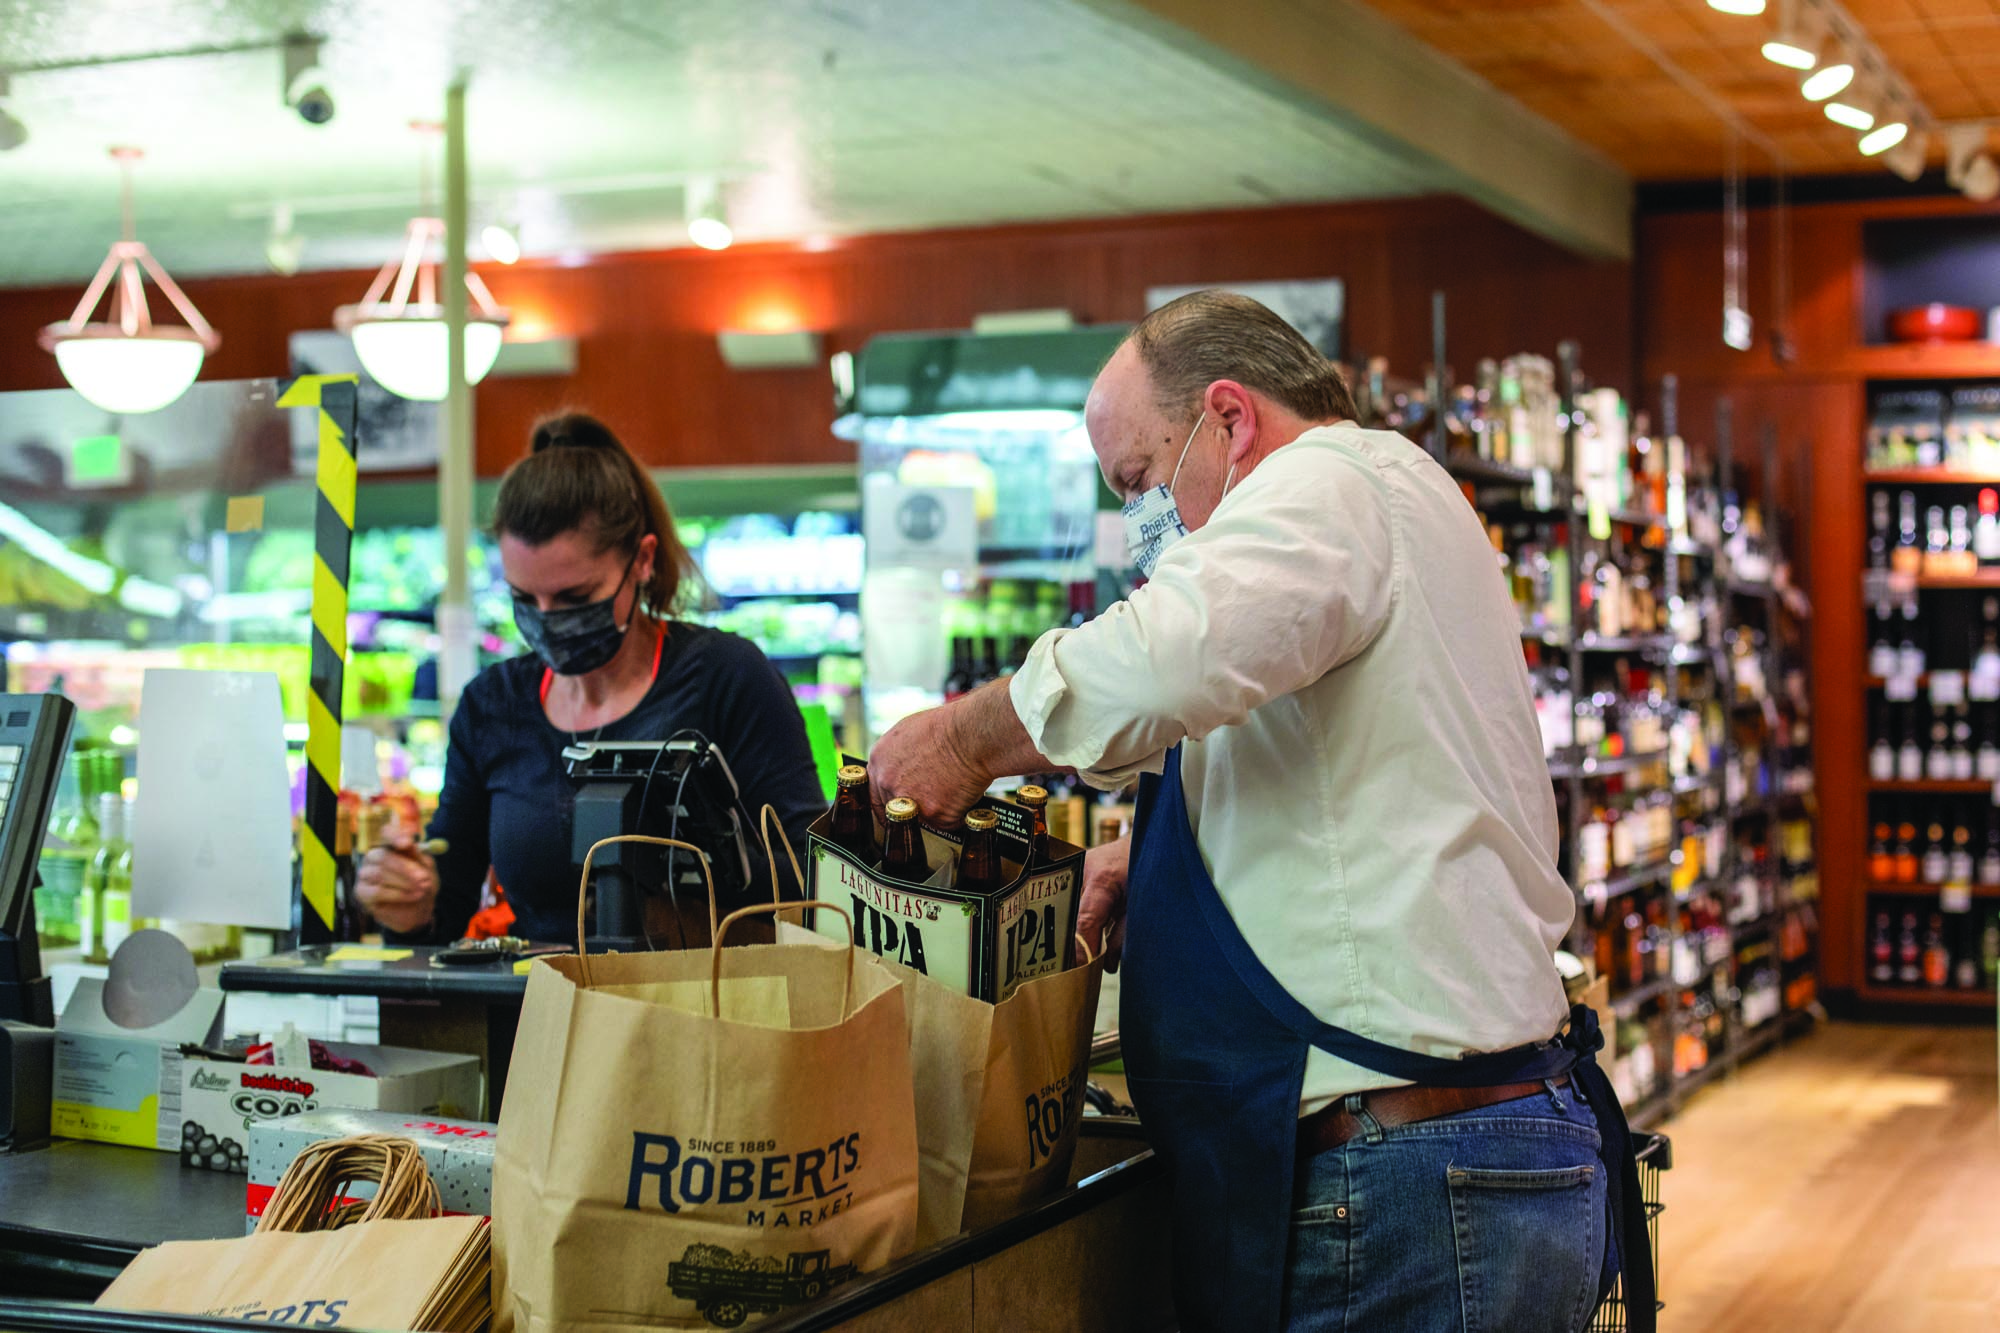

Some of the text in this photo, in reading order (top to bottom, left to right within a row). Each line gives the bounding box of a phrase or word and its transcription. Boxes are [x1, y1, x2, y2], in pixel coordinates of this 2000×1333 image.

[1140, 507, 1180, 541] ROBER
[840, 863, 923, 919] LAGUNITAS
[850, 892, 928, 976] IPA
[1004, 903, 1057, 987] IPA
[1038, 961, 1057, 975] ALE
[1040, 1076, 1067, 1099] SINCE
[688, 1137, 776, 1154] SINCE 1889
[623, 1130, 860, 1214] ROBERTS
[747, 1192, 854, 1228] MARKET
